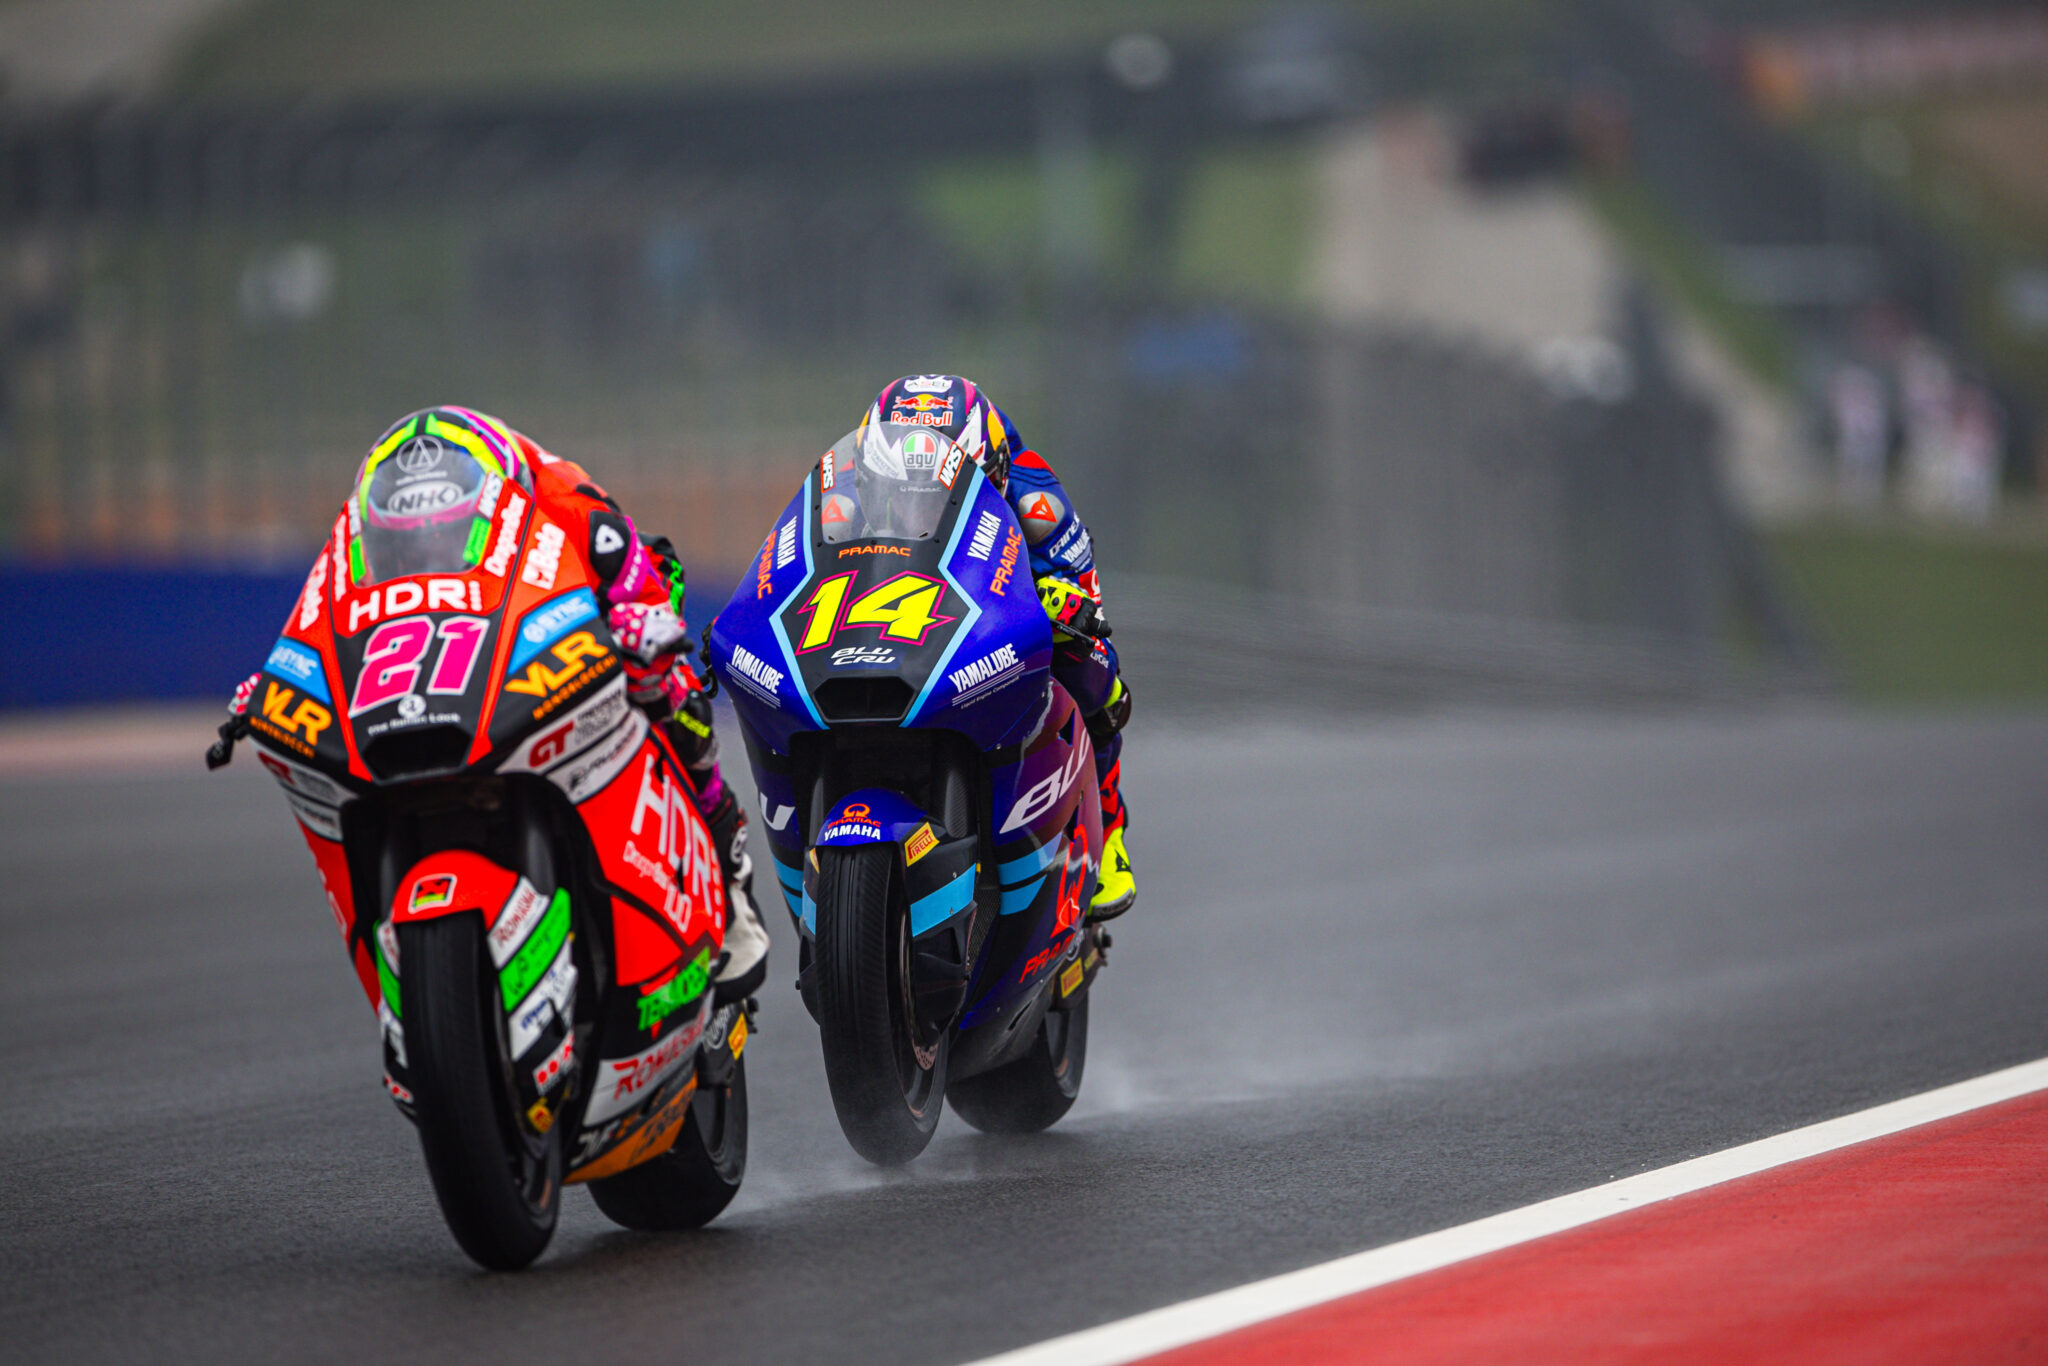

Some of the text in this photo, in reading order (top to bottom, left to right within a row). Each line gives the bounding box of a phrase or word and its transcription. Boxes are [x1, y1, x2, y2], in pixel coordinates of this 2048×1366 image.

[891, 411, 920, 426] Red
[922, 411, 952, 426] Bull
[907, 454, 934, 469] agv
[940, 443, 963, 488] WRS
[777, 515, 797, 570] YAMAHA
[838, 544, 912, 559] PRAMAC
[967, 510, 1002, 562] YAMAHA
[989, 525, 1022, 597] PRAMAC
[796, 571, 951, 654] 14
[348, 615, 490, 718] 21
[504, 631, 609, 698] VLR
[731, 644, 784, 694] YAMALUBE
[831, 646, 893, 659] BLU
[833, 655, 896, 666] CRU
[948, 643, 1019, 693] YAMALUBE
[262, 681, 332, 746] VLR
[528, 719, 575, 768] GT
[824, 825, 881, 841] YAMAHA
[827, 817, 881, 829] PRAMAC
[907, 829, 933, 860] PIRELLI
